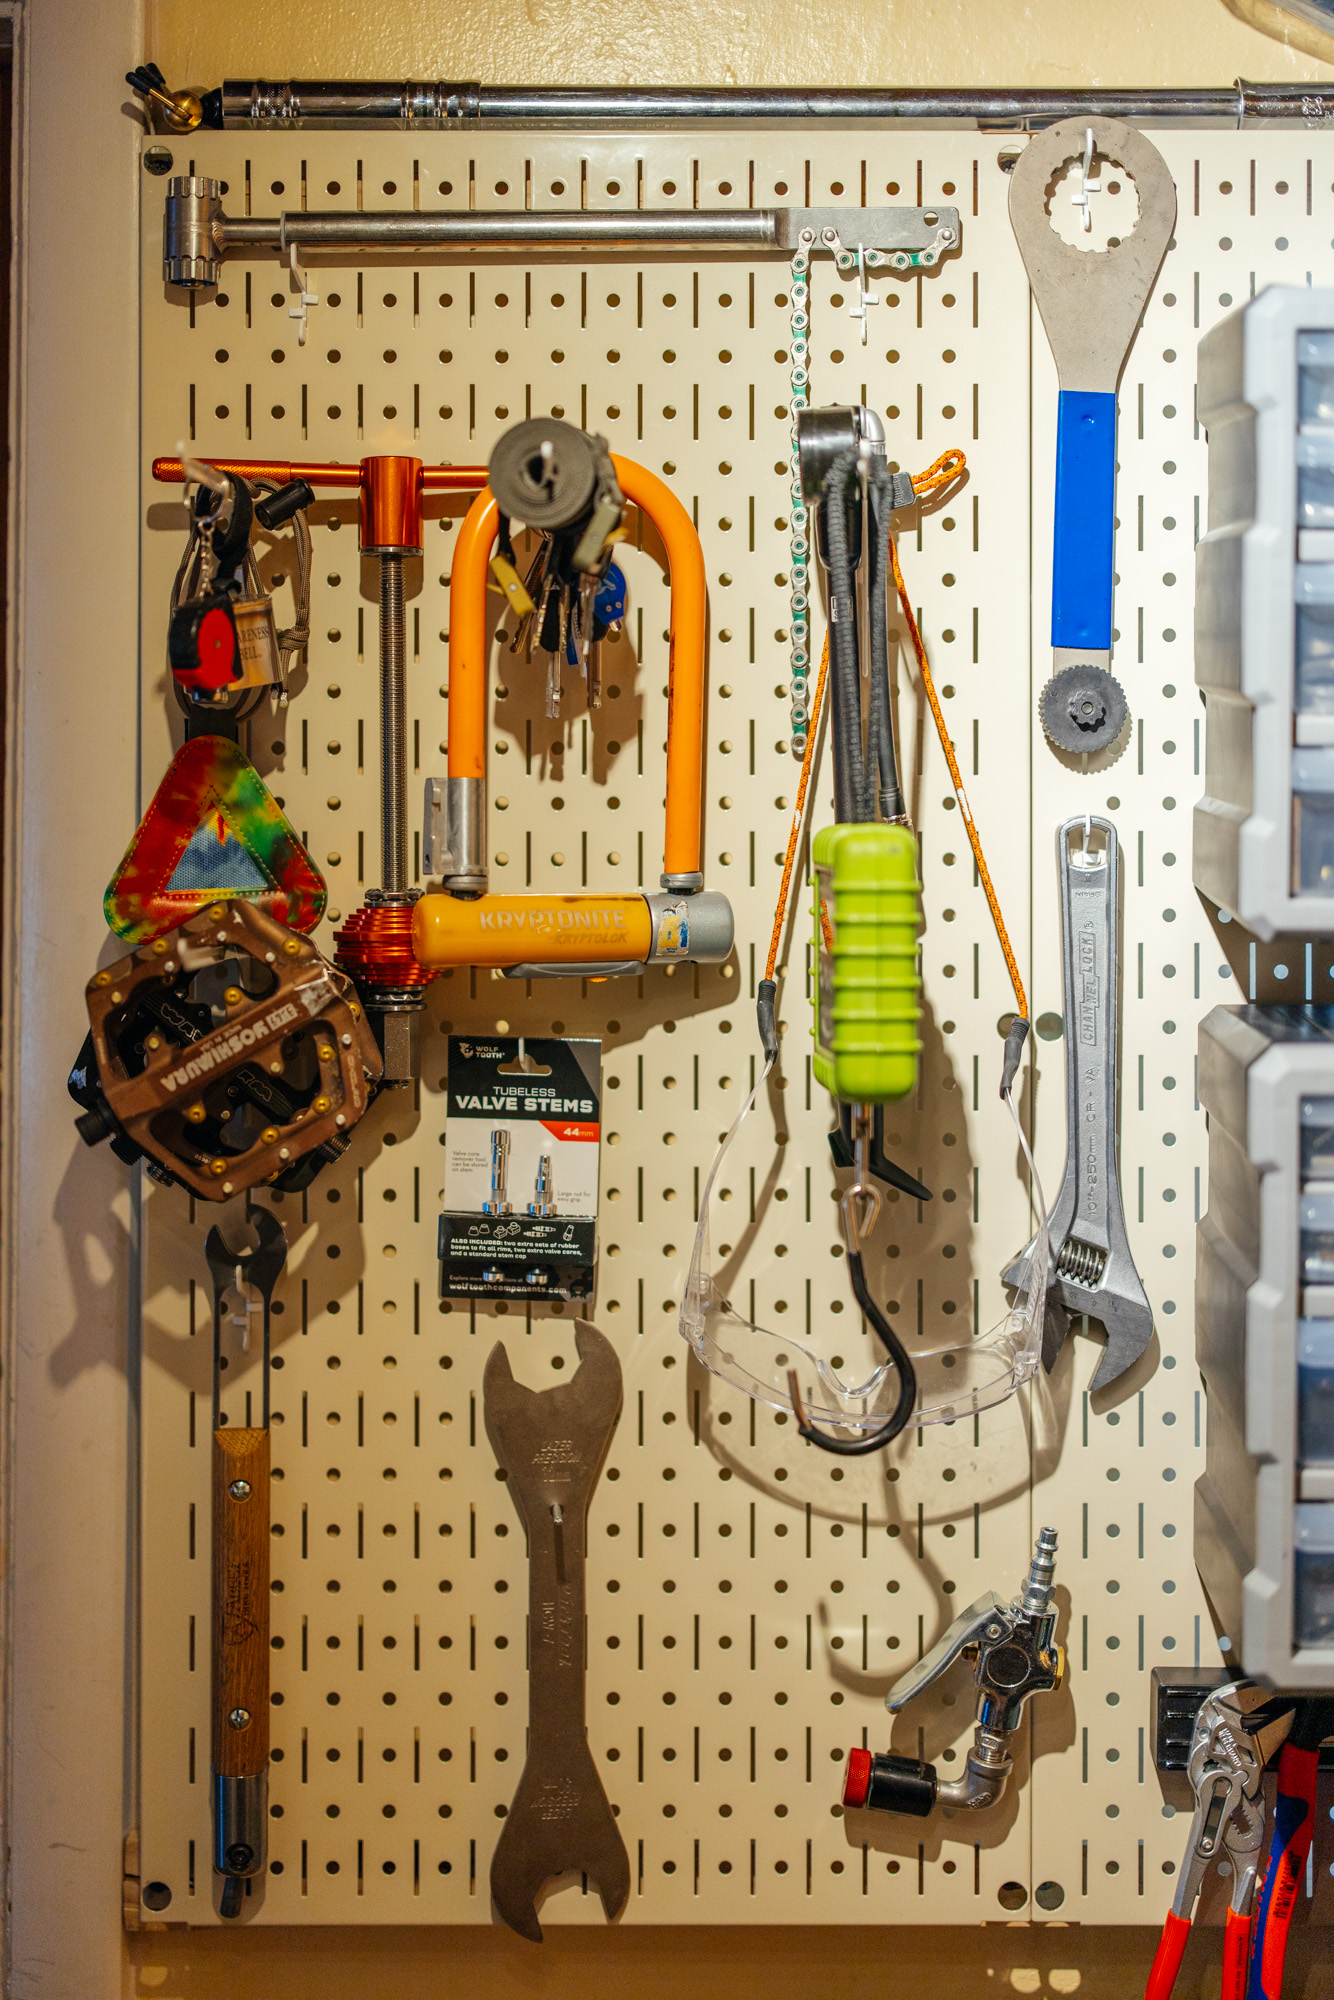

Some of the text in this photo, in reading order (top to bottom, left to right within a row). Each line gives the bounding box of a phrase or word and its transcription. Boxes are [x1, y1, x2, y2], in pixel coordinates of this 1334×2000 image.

[237, 626, 270, 643] ARENESS
[480, 909, 627, 931] KRYPTONITE
[160, 1020, 270, 1092] YOSHIMURA
[493, 1086, 556, 1097] TUBELESS
[455, 1095, 593, 1113] VALVE STEMS
[563, 1128, 594, 1137] 44mm
[449, 1282, 568, 1294] wolftoothcomponents.com
